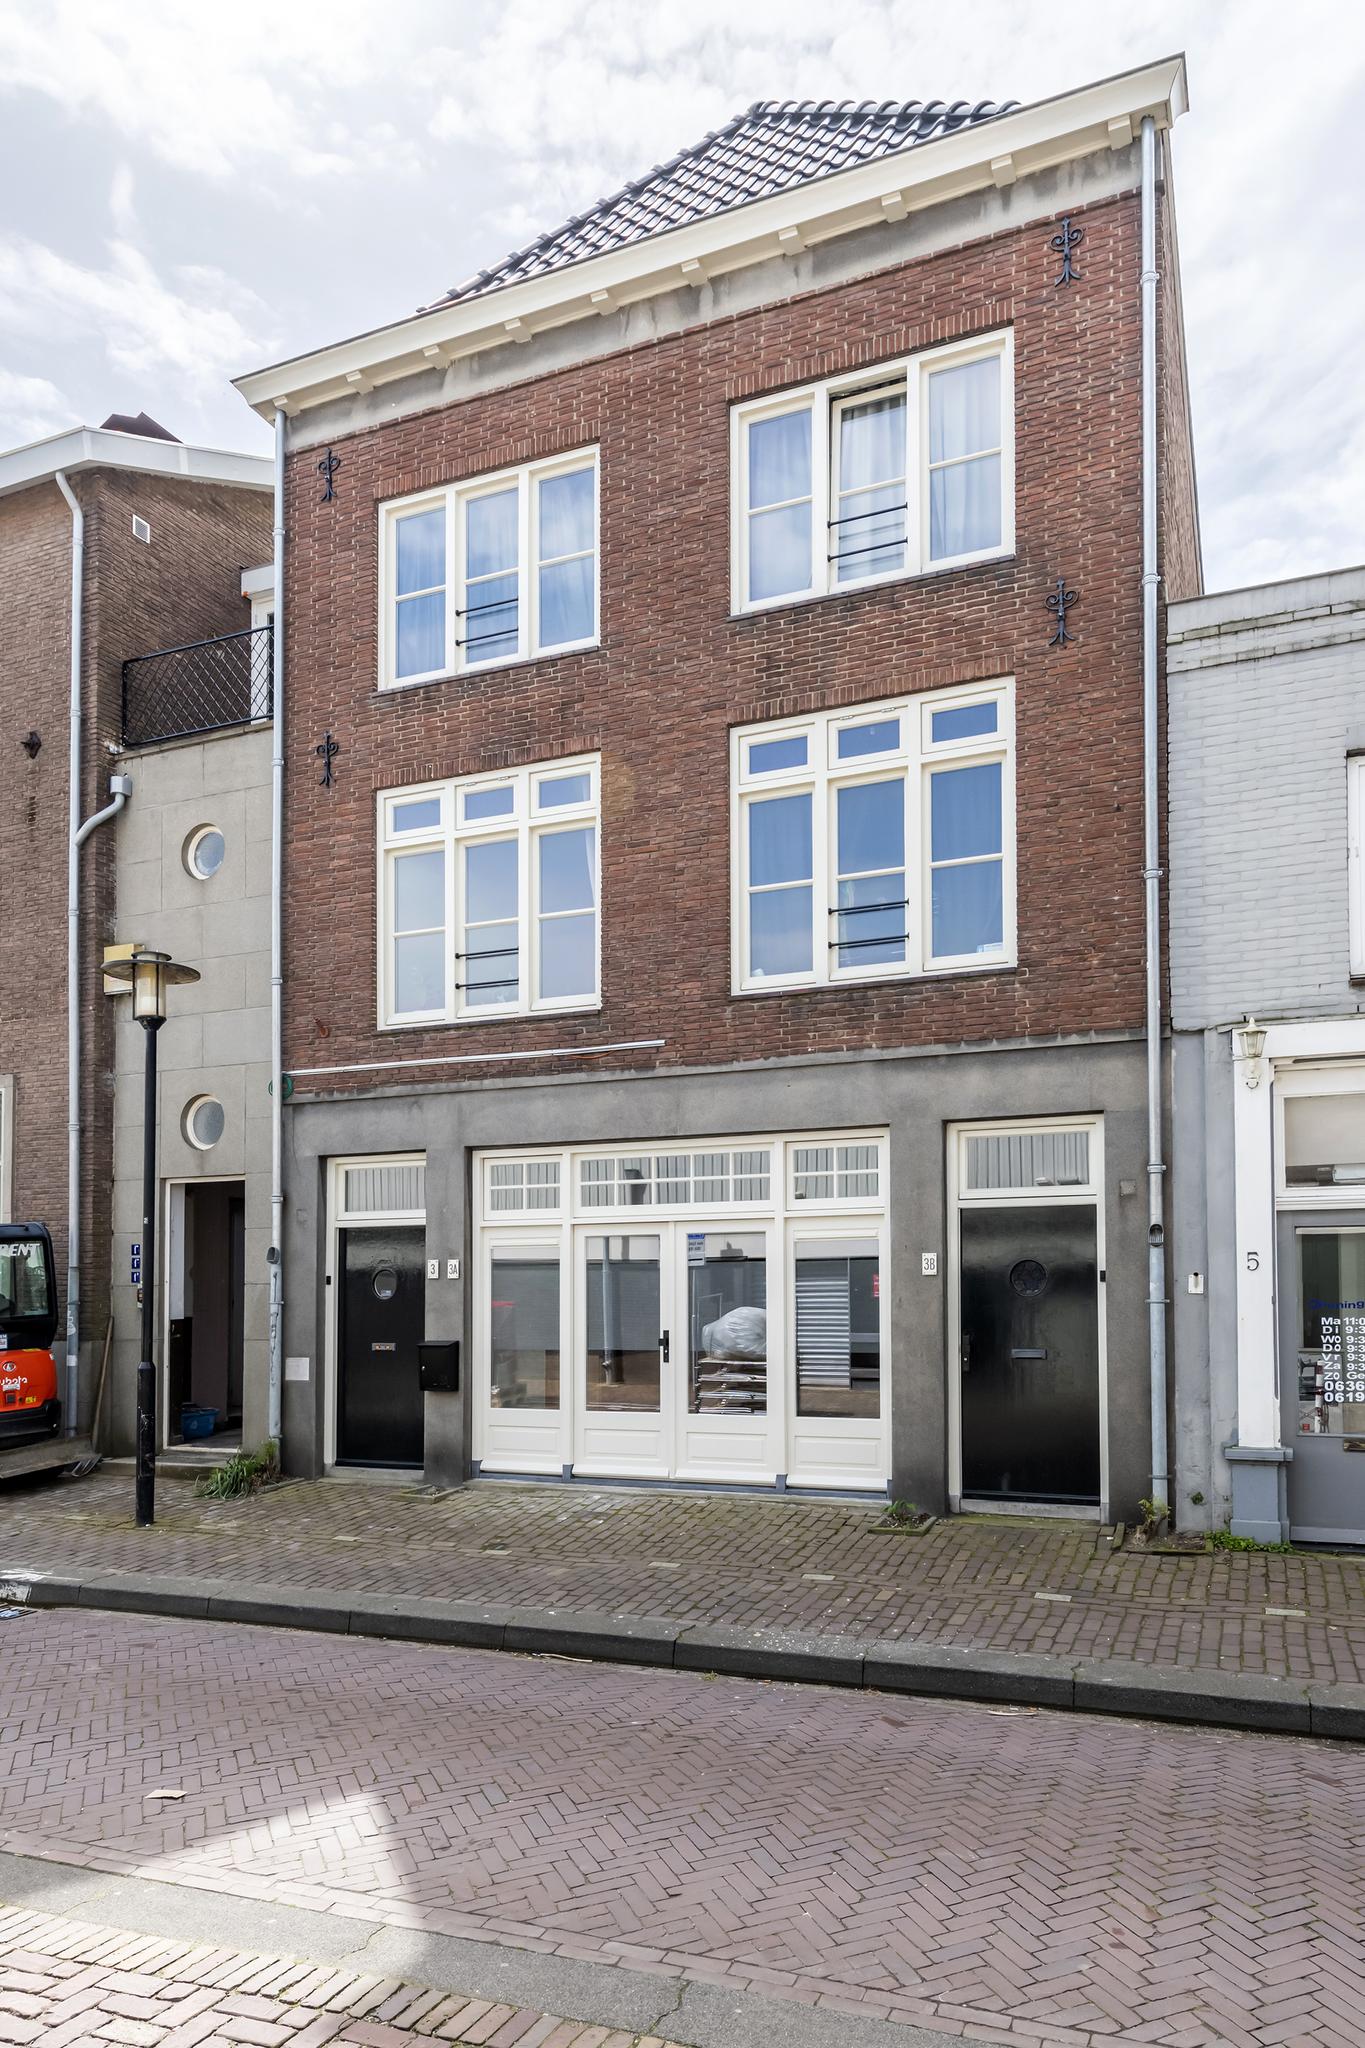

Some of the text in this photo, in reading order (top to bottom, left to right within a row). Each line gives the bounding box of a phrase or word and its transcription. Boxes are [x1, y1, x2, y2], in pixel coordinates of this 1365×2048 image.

[1247, 1251, 1259, 1271] 5
[430, 1263, 436, 1275] 3
[448, 1263, 458, 1275] 3A
[1321, 1316, 1341, 1325] Ma
[1322, 1325, 1339, 1334] Di
[1321, 1352, 1341, 1361] Vr
[1323, 1361, 1341, 1370] Za
